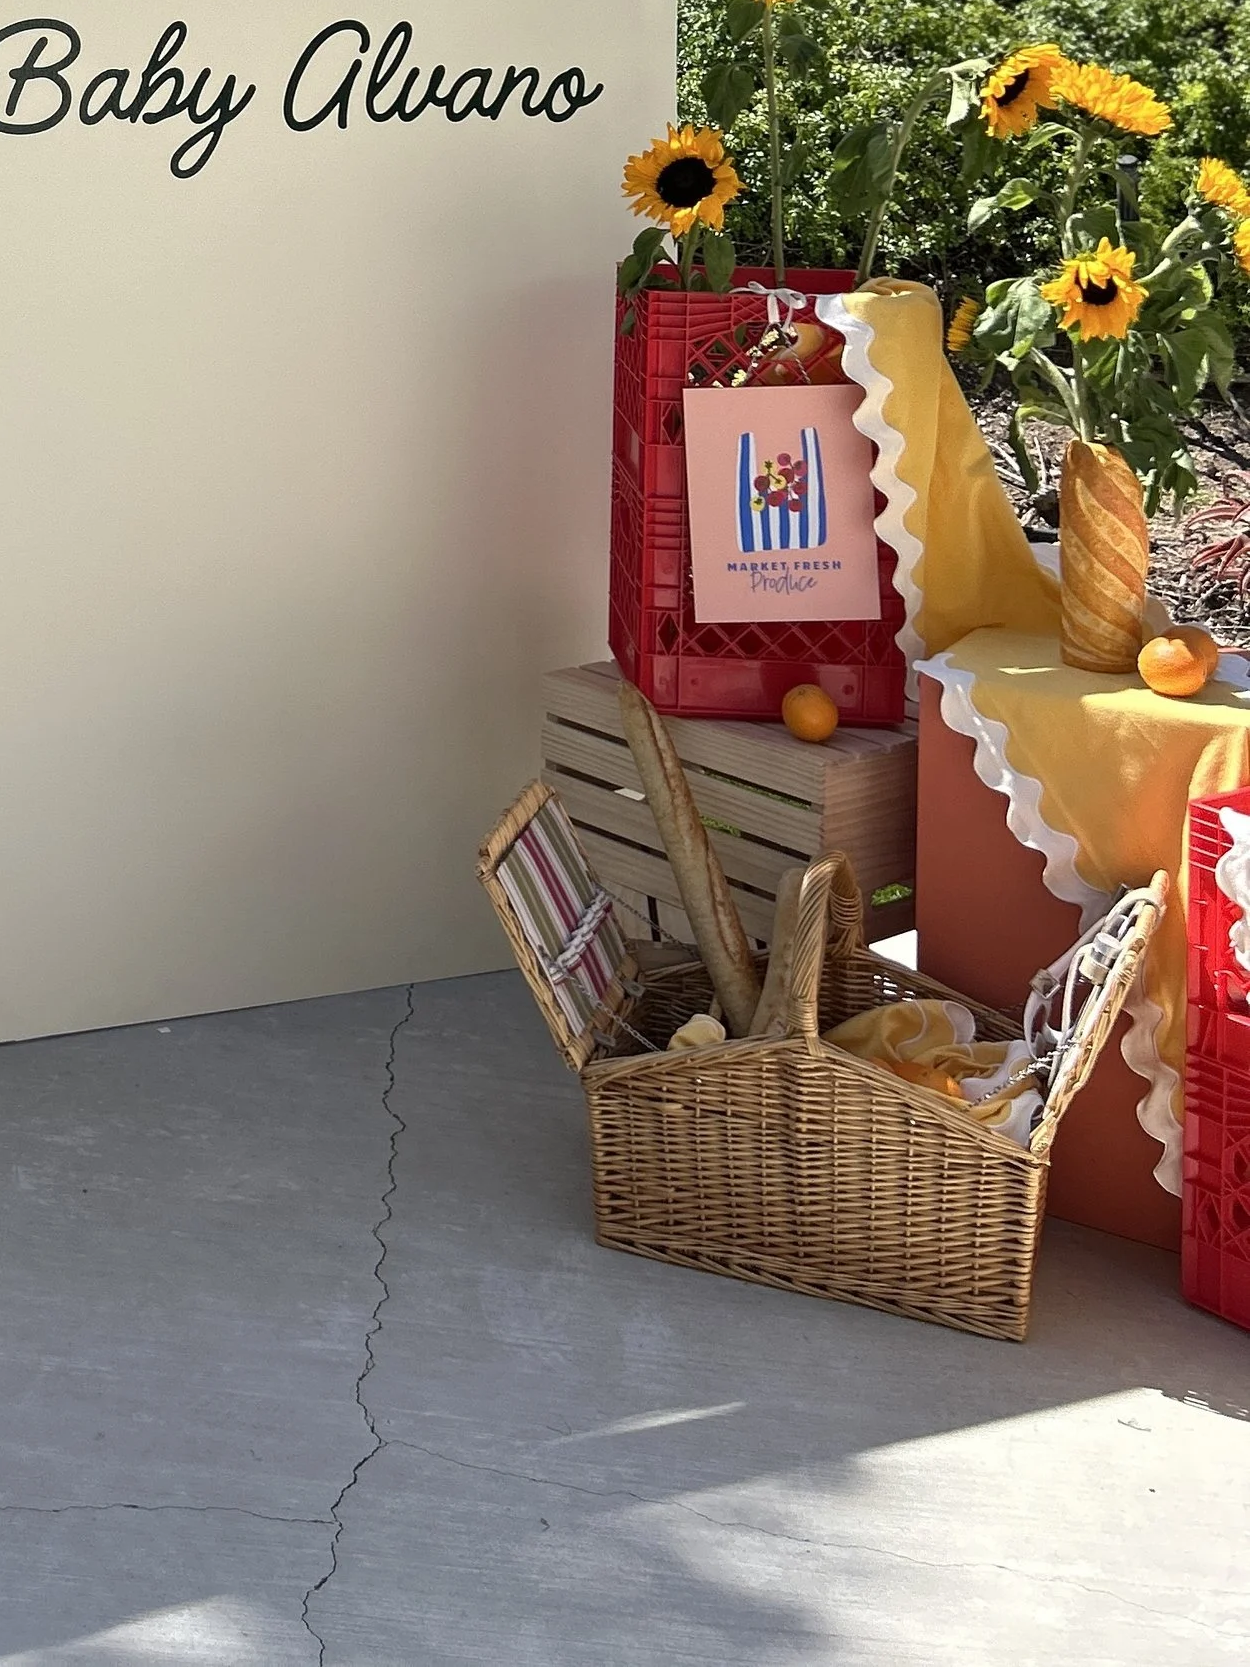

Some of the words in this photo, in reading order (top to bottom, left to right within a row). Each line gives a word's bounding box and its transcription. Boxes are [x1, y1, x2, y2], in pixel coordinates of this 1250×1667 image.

[283, 19, 605, 133] Alvano
[726, 561, 787, 572] MARKET
[793, 560, 842, 571] FRESH
[749, 566, 818, 596] Produce
